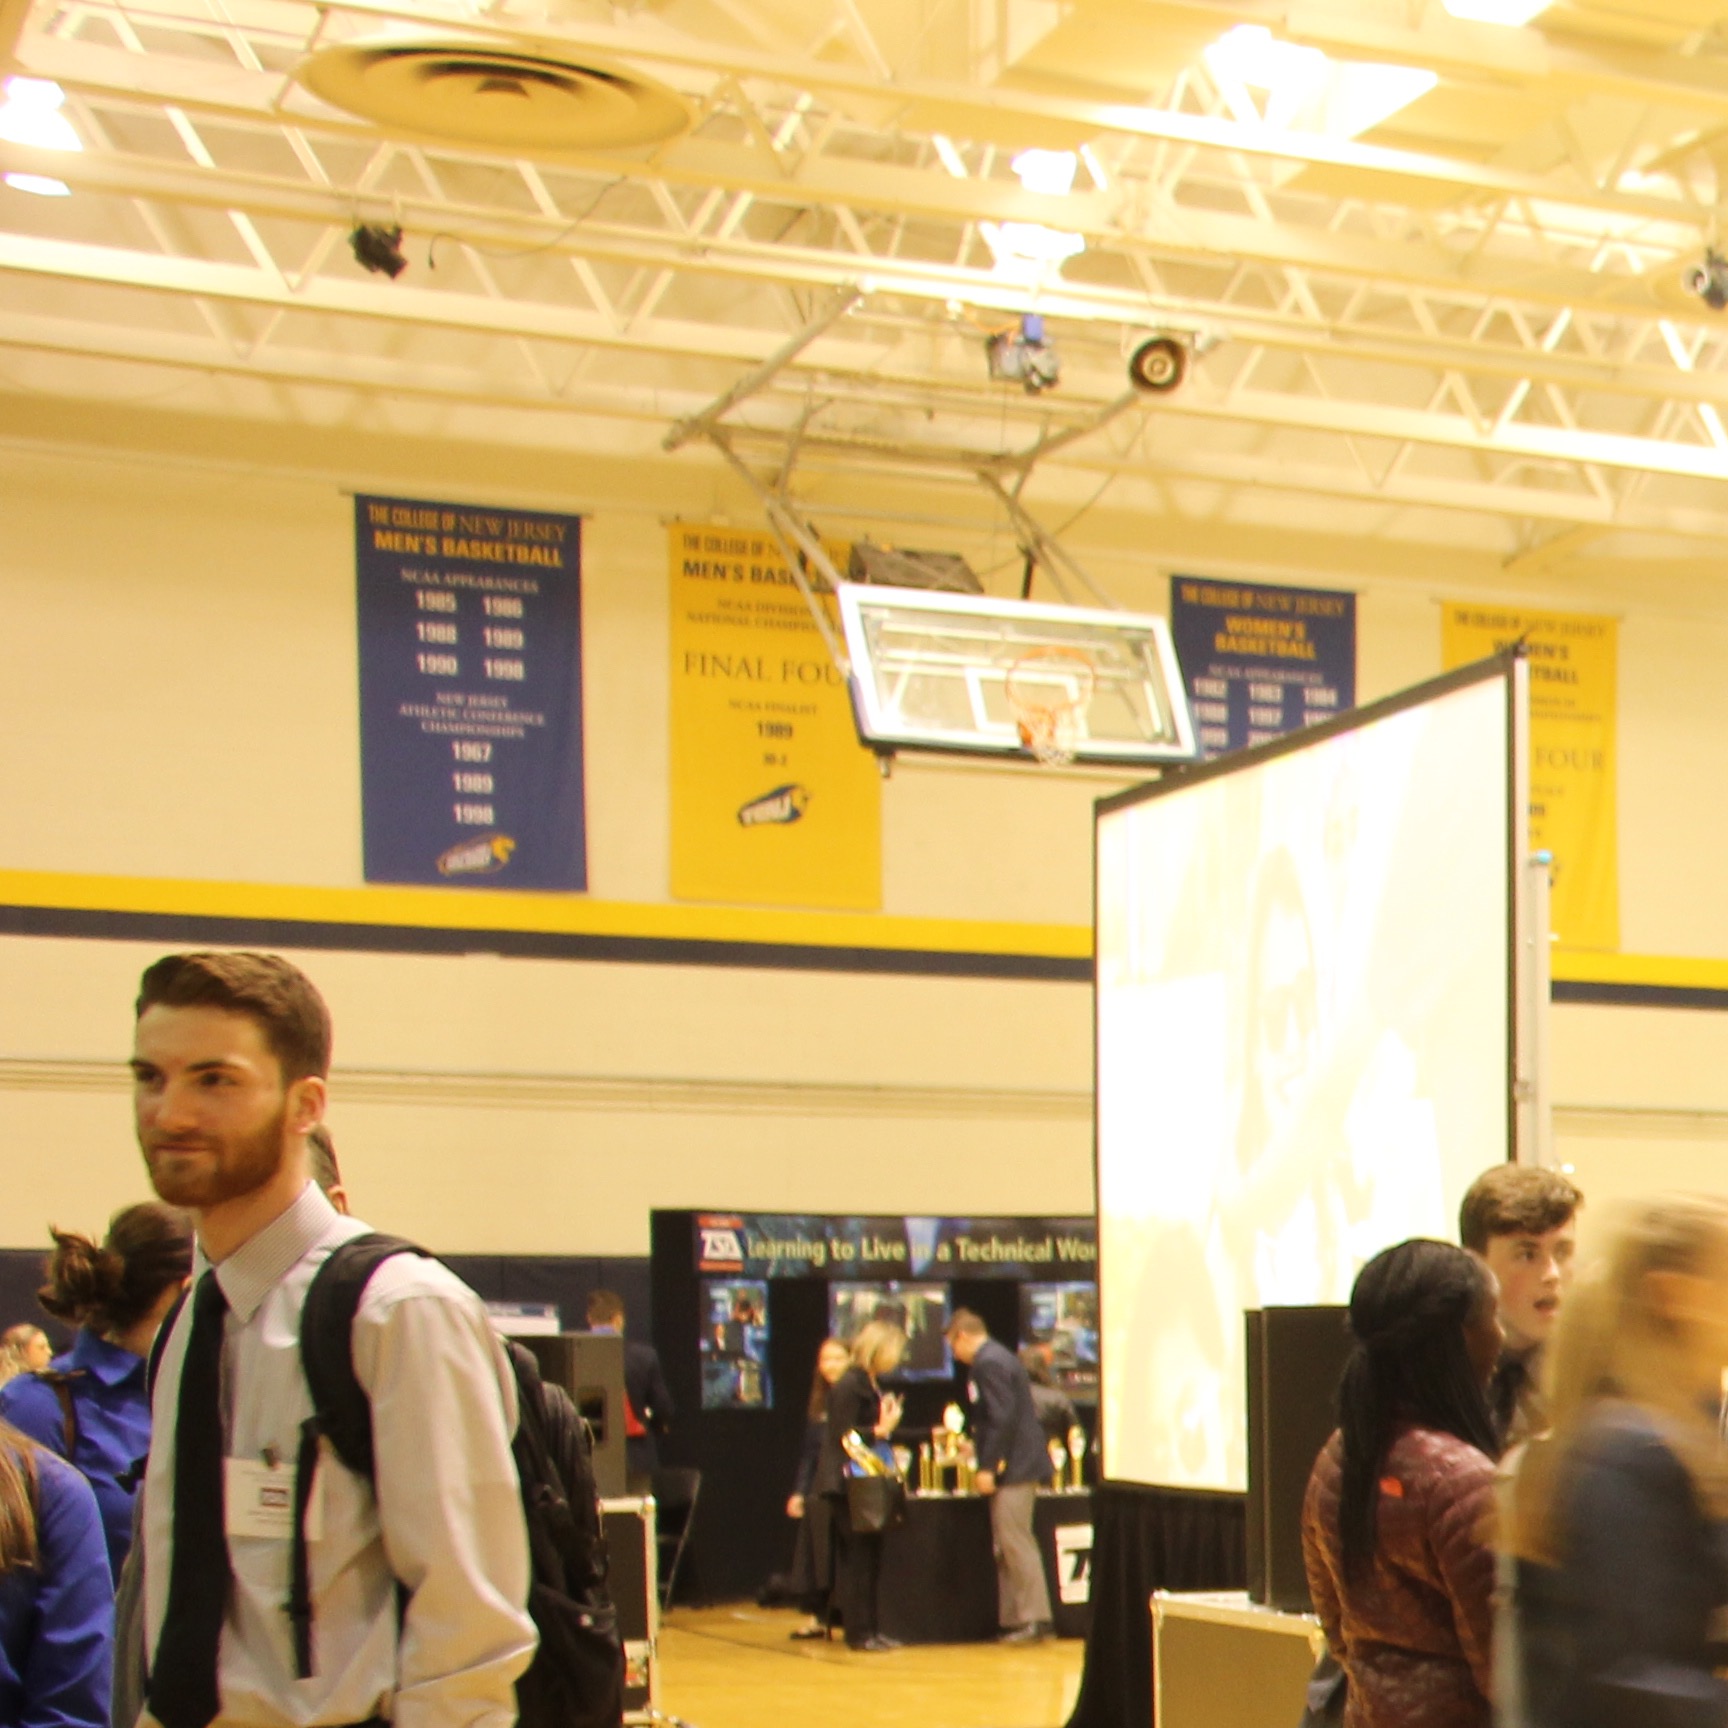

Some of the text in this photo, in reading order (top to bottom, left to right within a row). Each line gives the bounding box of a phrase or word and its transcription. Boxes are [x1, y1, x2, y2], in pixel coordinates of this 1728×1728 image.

[368, 503, 567, 543] THE COLLEGE OF NEW JERSEY
[373, 529, 565, 569] MEN'S BASKETBALL
[401, 568, 540, 595] NCAA APPEARANCES
[1214, 632, 1318, 661] BASKETBALL
[1225, 615, 1306, 640] WOMEN'S
[683, 650, 843, 688] FINAL FOU
[700, 1229, 744, 1261] TSA
[748, 1235, 828, 1268] Learning
[831, 1237, 856, 1261] to
[861, 1234, 906, 1262] Live
[936, 1241, 951, 1262] a
[955, 1235, 1054, 1262] Technical
[1056, 1235, 1097, 1262] Wor
